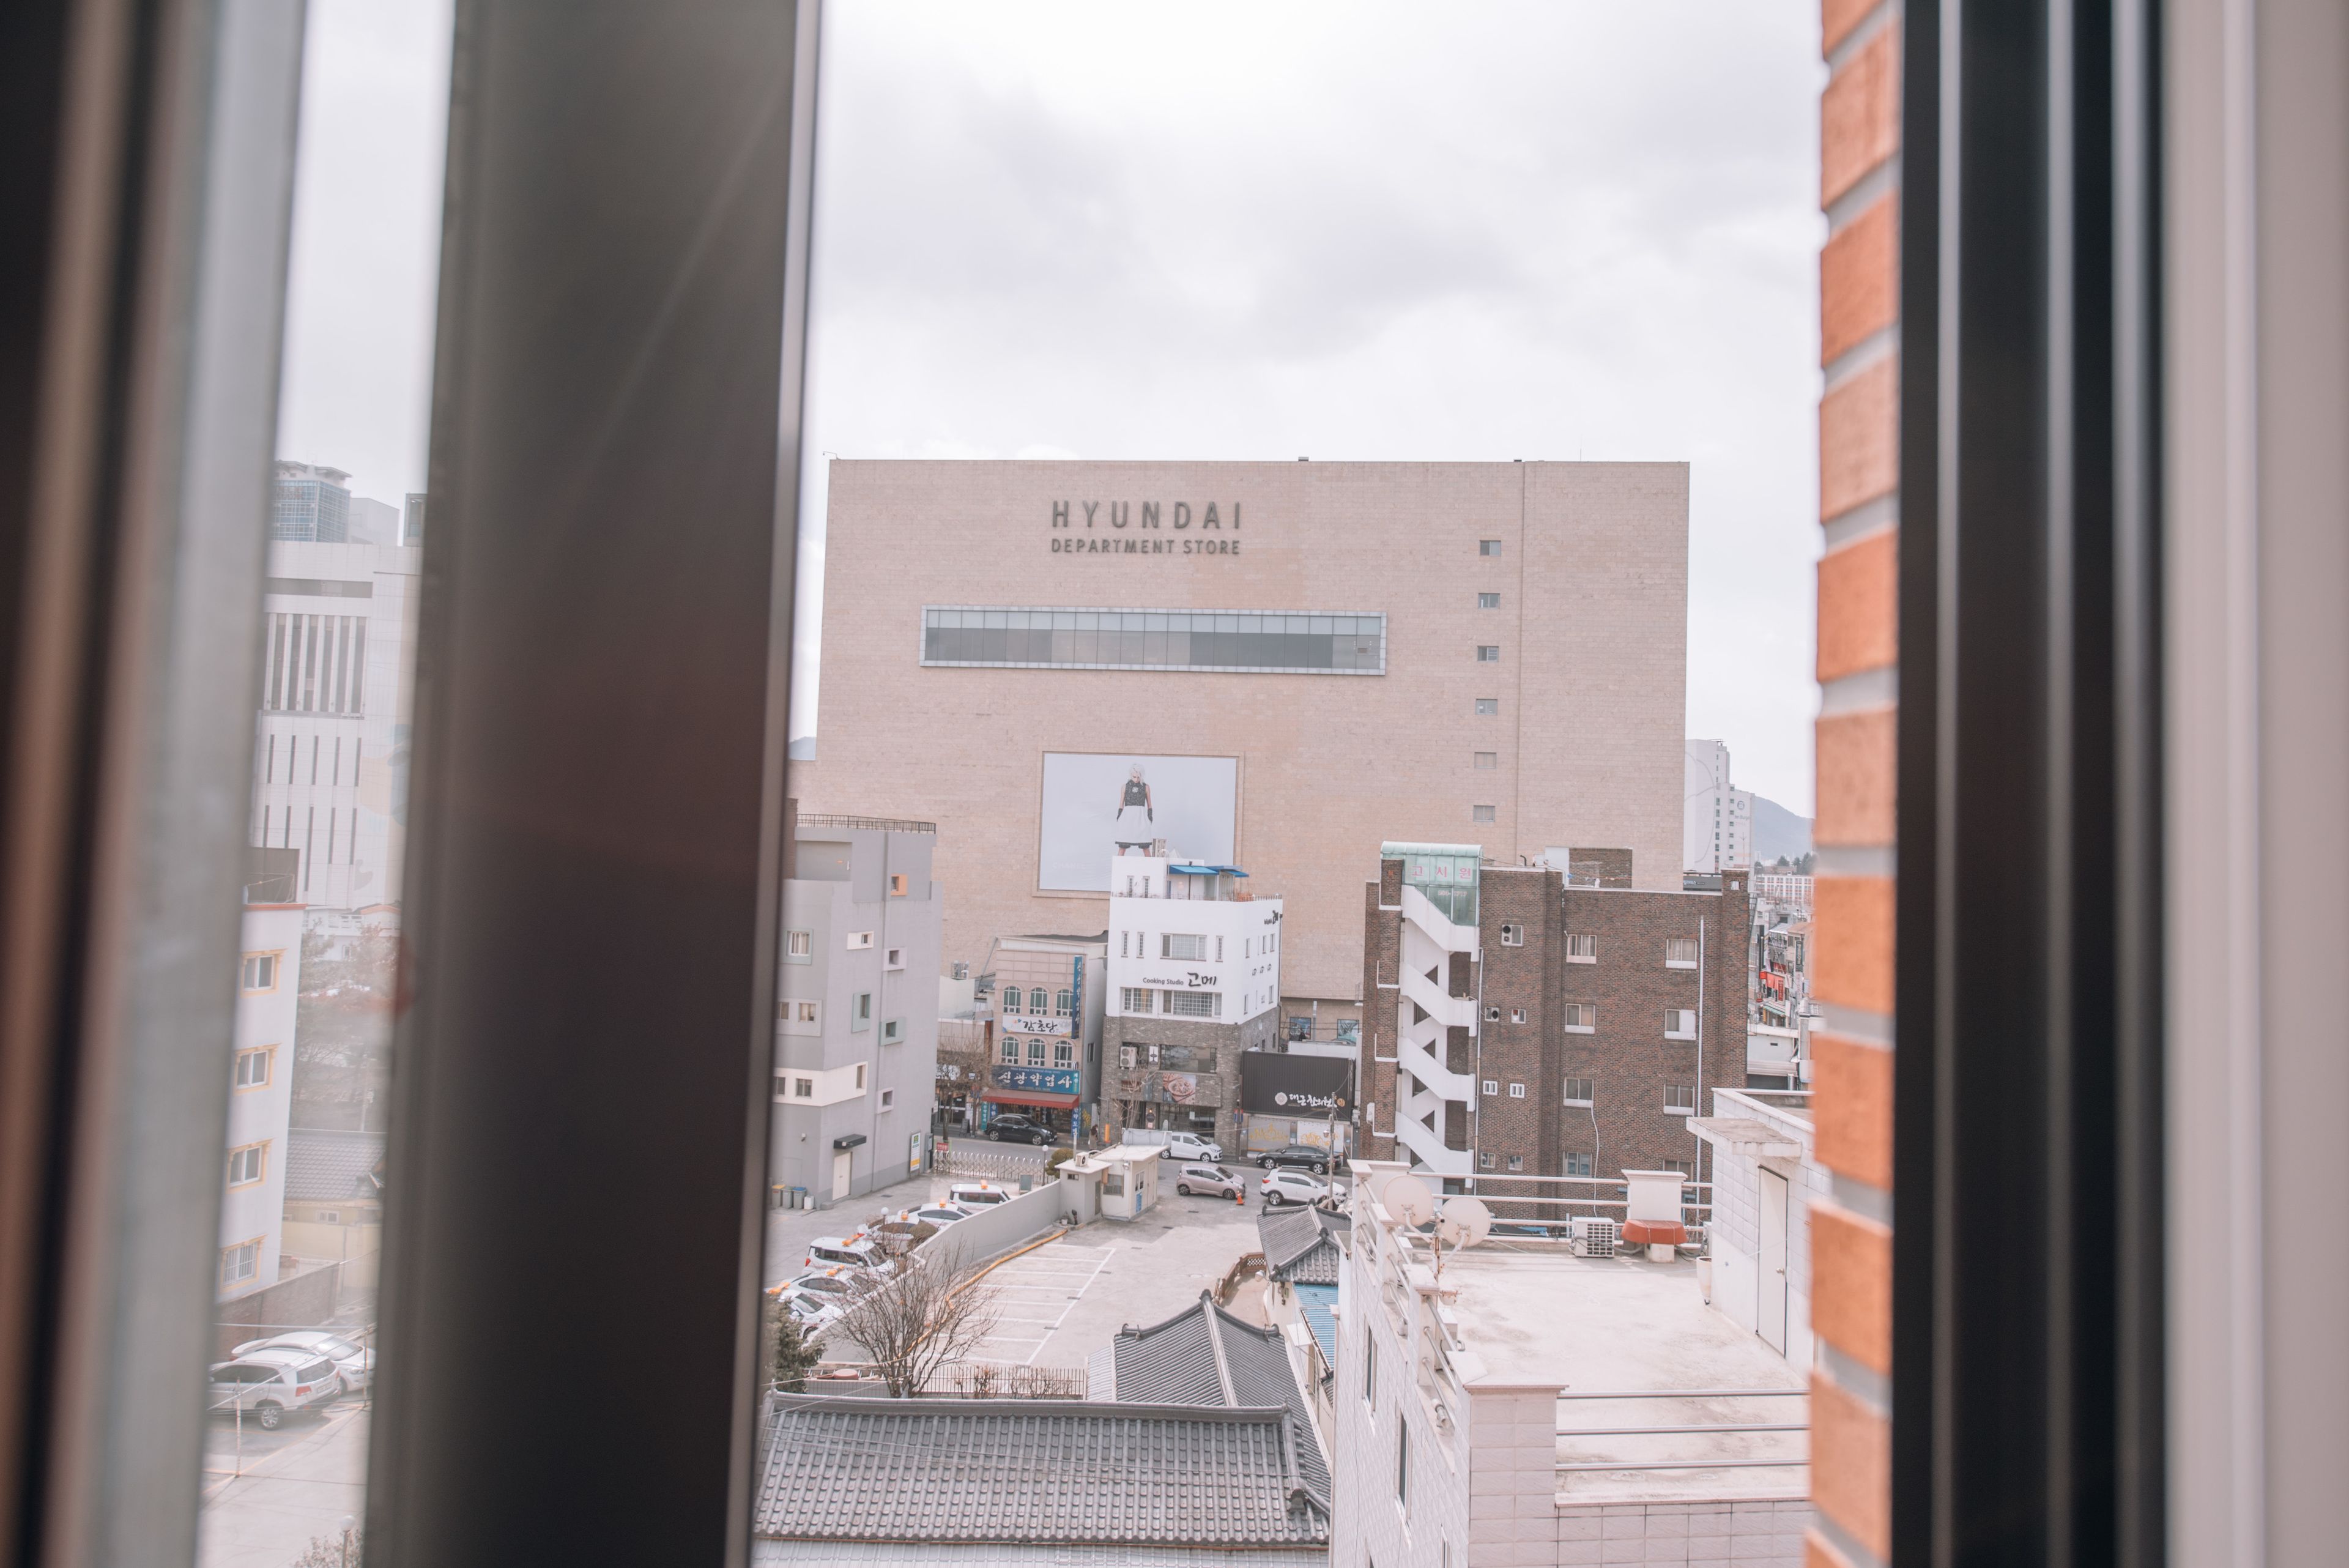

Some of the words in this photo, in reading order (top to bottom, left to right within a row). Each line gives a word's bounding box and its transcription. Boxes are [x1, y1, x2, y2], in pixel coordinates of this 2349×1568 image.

[1052, 500, 1240, 529] HYUNDAI
[1052, 538, 1174, 554] DEPARTMENT
[1183, 540, 1240, 555] STORE
[1411, 866, 1471, 879] 고시원
[1187, 972, 1217, 987] 고메
[1023, 1019, 1058, 1033] 감초당
[998, 1071, 1072, 1088] 신광약업사
